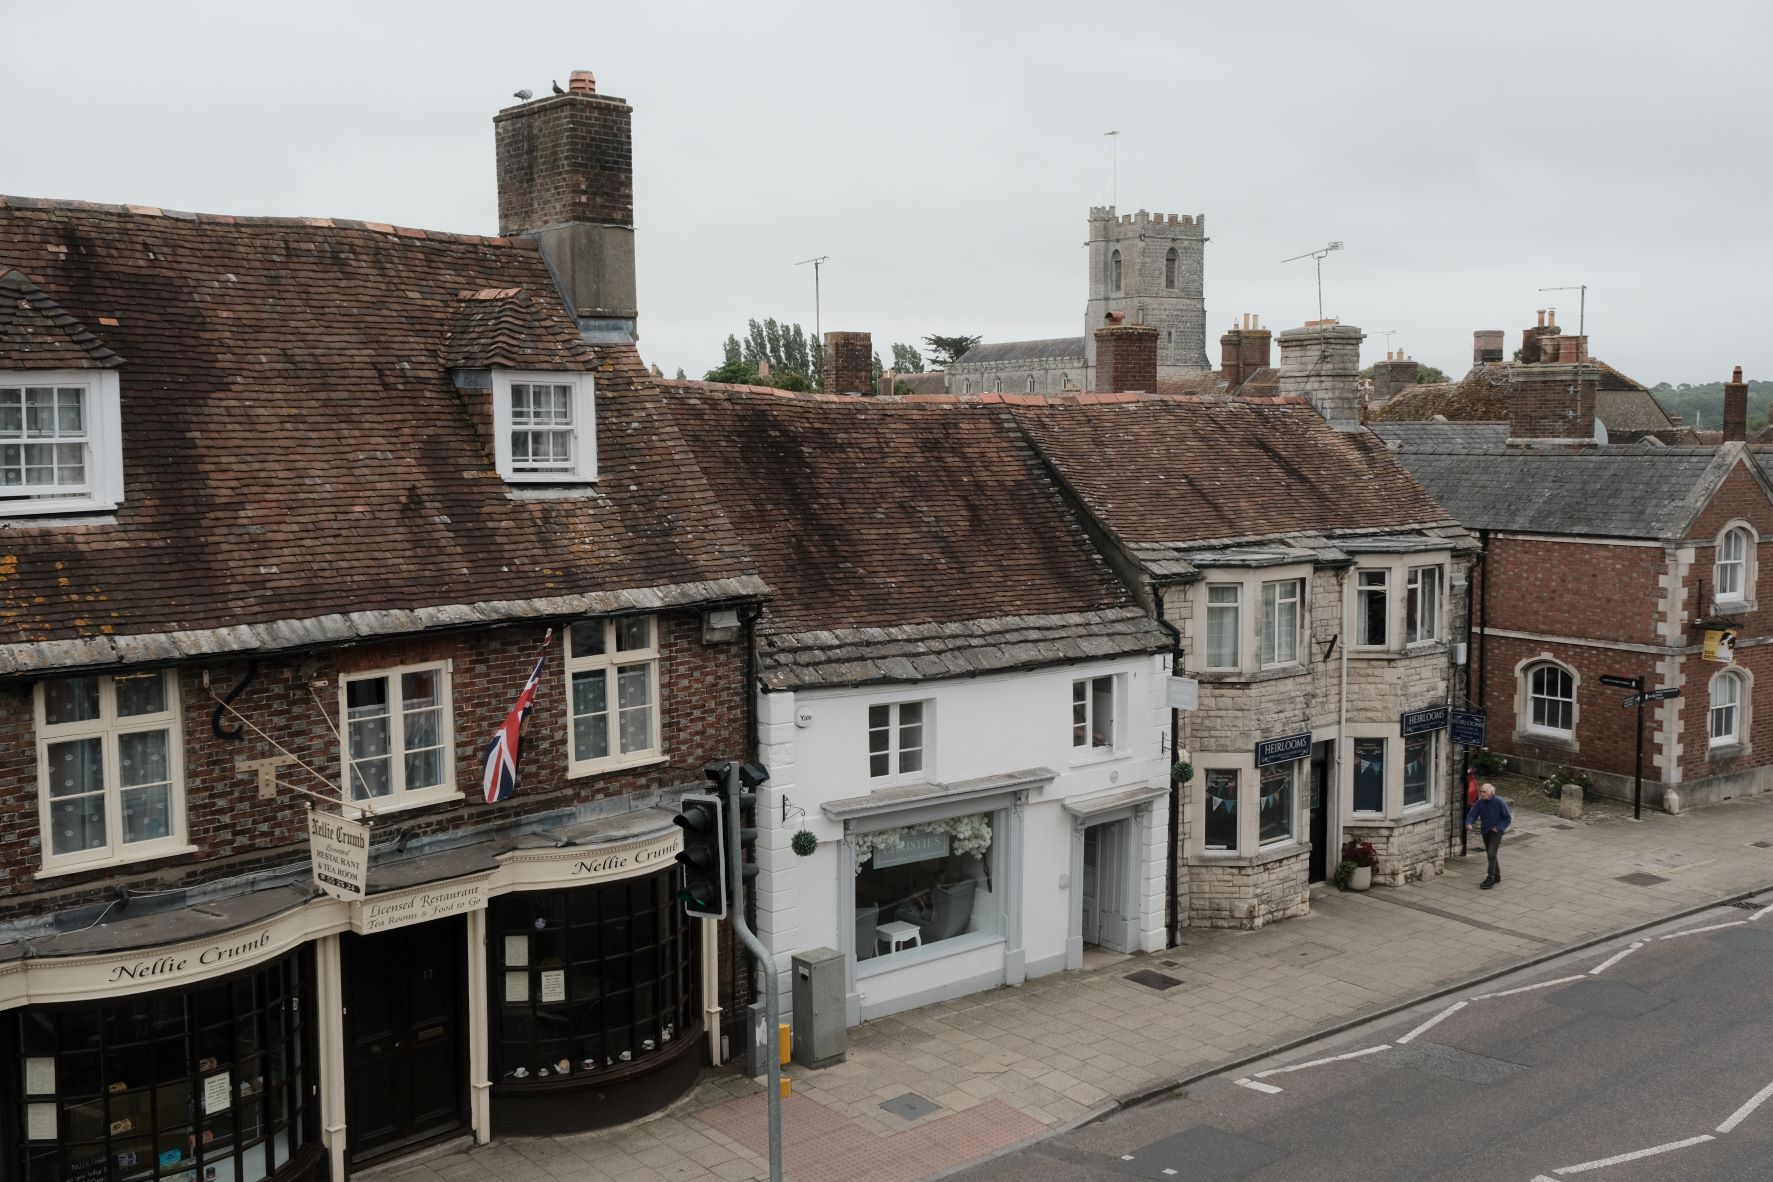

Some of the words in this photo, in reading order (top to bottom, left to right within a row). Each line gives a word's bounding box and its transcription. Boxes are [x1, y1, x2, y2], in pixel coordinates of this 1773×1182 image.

[1409, 709, 1445, 725] HEIRLOOMS
[1264, 737, 1307, 755] HEIRLOOMS
[312, 817, 335, 840] Nellie
[336, 825, 365, 849] Crumb
[316, 849, 360, 870] RESTAURANT
[324, 863, 336, 875] TEA
[337, 868, 358, 881] ROOM
[571, 854, 627, 875] Nellie
[635, 837, 679, 863] Crumb
[367, 920, 384, 930] Tea
[388, 912, 418, 925] Rooms
[430, 901, 454, 917] Food
[468, 897, 482, 906] Go
[370, 896, 416, 918] Licensed
[421, 886, 480, 908] Restaurant
[108, 956, 187, 982] Nellie
[199, 929, 270, 965] Crumb
